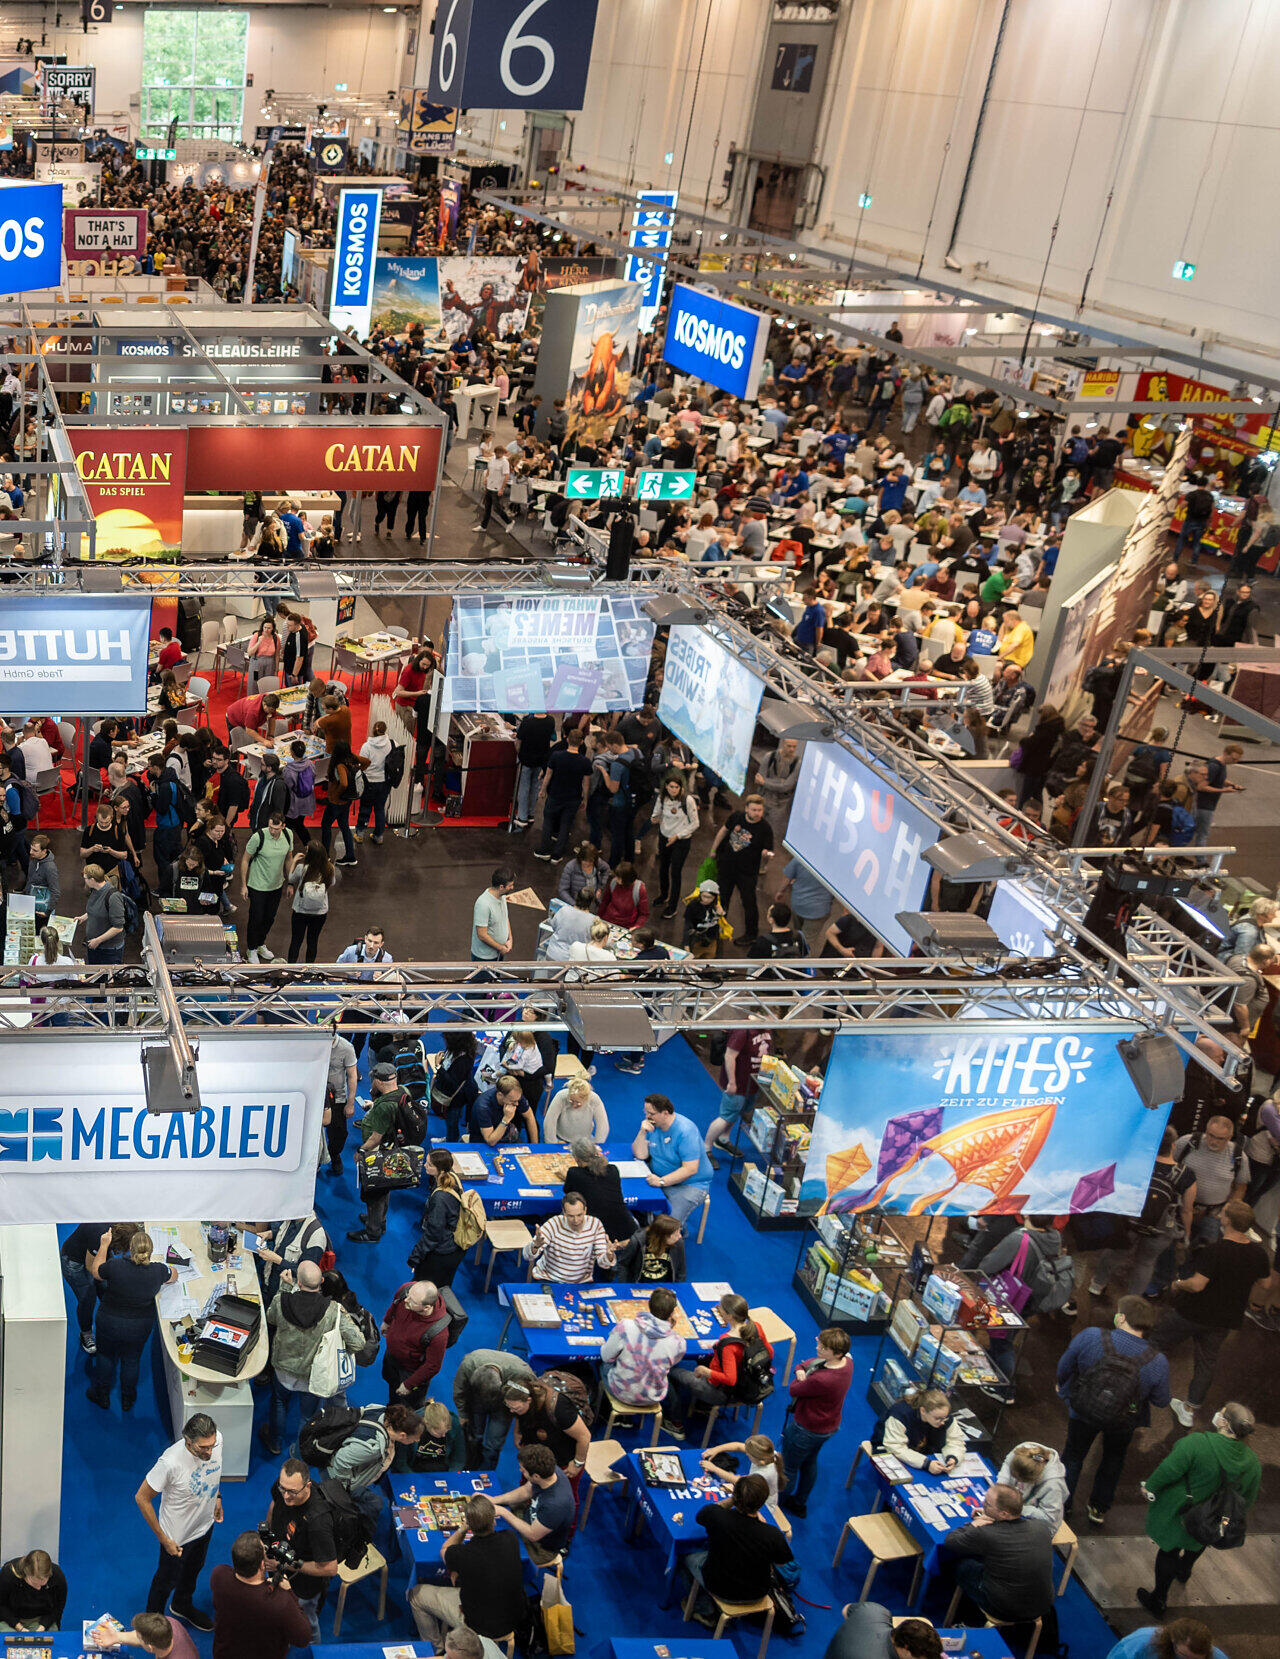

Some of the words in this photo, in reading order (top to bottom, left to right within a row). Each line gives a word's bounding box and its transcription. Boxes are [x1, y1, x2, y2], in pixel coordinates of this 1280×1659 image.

[49, 72, 91, 86] SORRY
[413, 132, 440, 141] HANS
[88, 220, 125, 232] THAT'S
[78, 235, 98, 246] NOT
[102, 235, 110, 246] A
[113, 234, 134, 246] HAT
[343, 202, 369, 296] KOSMOS
[674, 309, 746, 370] KOSMOS
[121, 345, 169, 356] KOSMOS
[1085, 373, 1119, 382] HARIBO
[325, 443, 421, 473] CATAN
[75, 450, 172, 481] CATAN
[99, 487, 118, 496] DAS
[121, 486, 146, 497] SPIEL
[948, 1036, 1082, 1094] KITES
[939, 1097, 973, 1107] ZEIT
[977, 1097, 996, 1107] ZU
[1002, 1095, 1066, 1107] FLIEGEN
[71, 1104, 290, 1161] MEGABLEU
